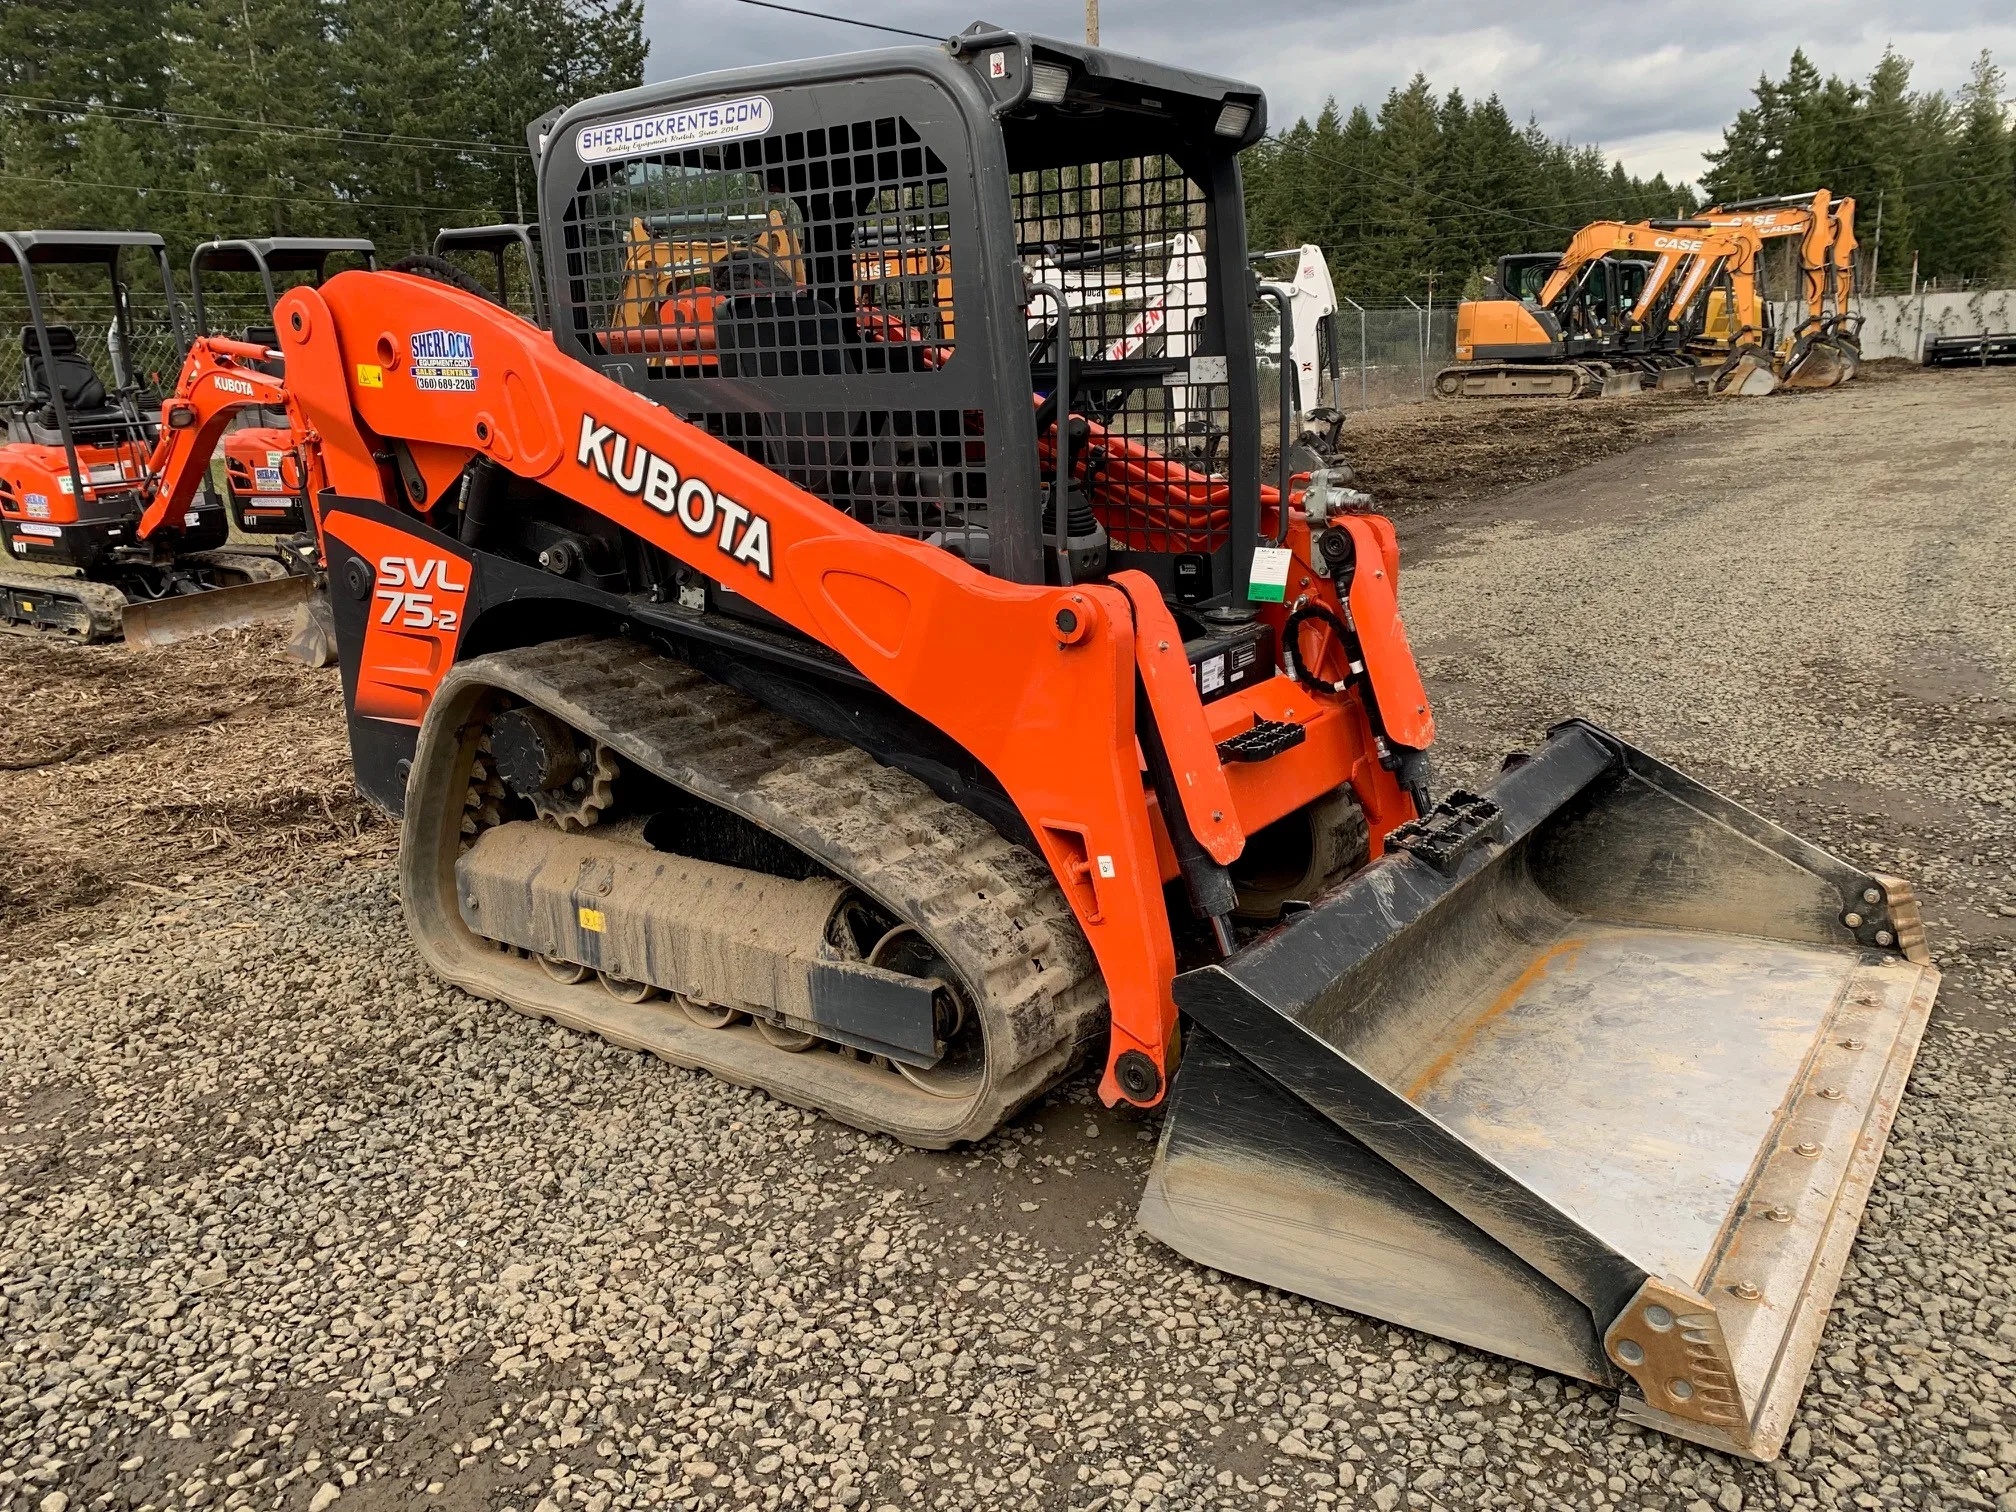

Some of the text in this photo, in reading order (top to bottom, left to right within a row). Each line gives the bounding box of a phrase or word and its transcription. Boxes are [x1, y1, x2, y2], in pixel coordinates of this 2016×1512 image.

[583, 102, 762, 149] SHERLOCKRENTS.COM
[606, 125, 739, 153] Quality Equipment Rentals Since 2014
[1654, 237, 1702, 251] CASE
[411, 331, 473, 359] SHERLOCK
[1112, 340, 1133, 361] WE
[416, 377, 476, 390] (360) 689-2208
[442, 369, 472, 377] RENTALS
[213, 375, 255, 397] KUBOTA
[576, 412, 772, 579] KUBOTA
[243, 515, 257, 526] U17
[378, 556, 465, 592] SVL
[376, 590, 458, 631] 75-2
